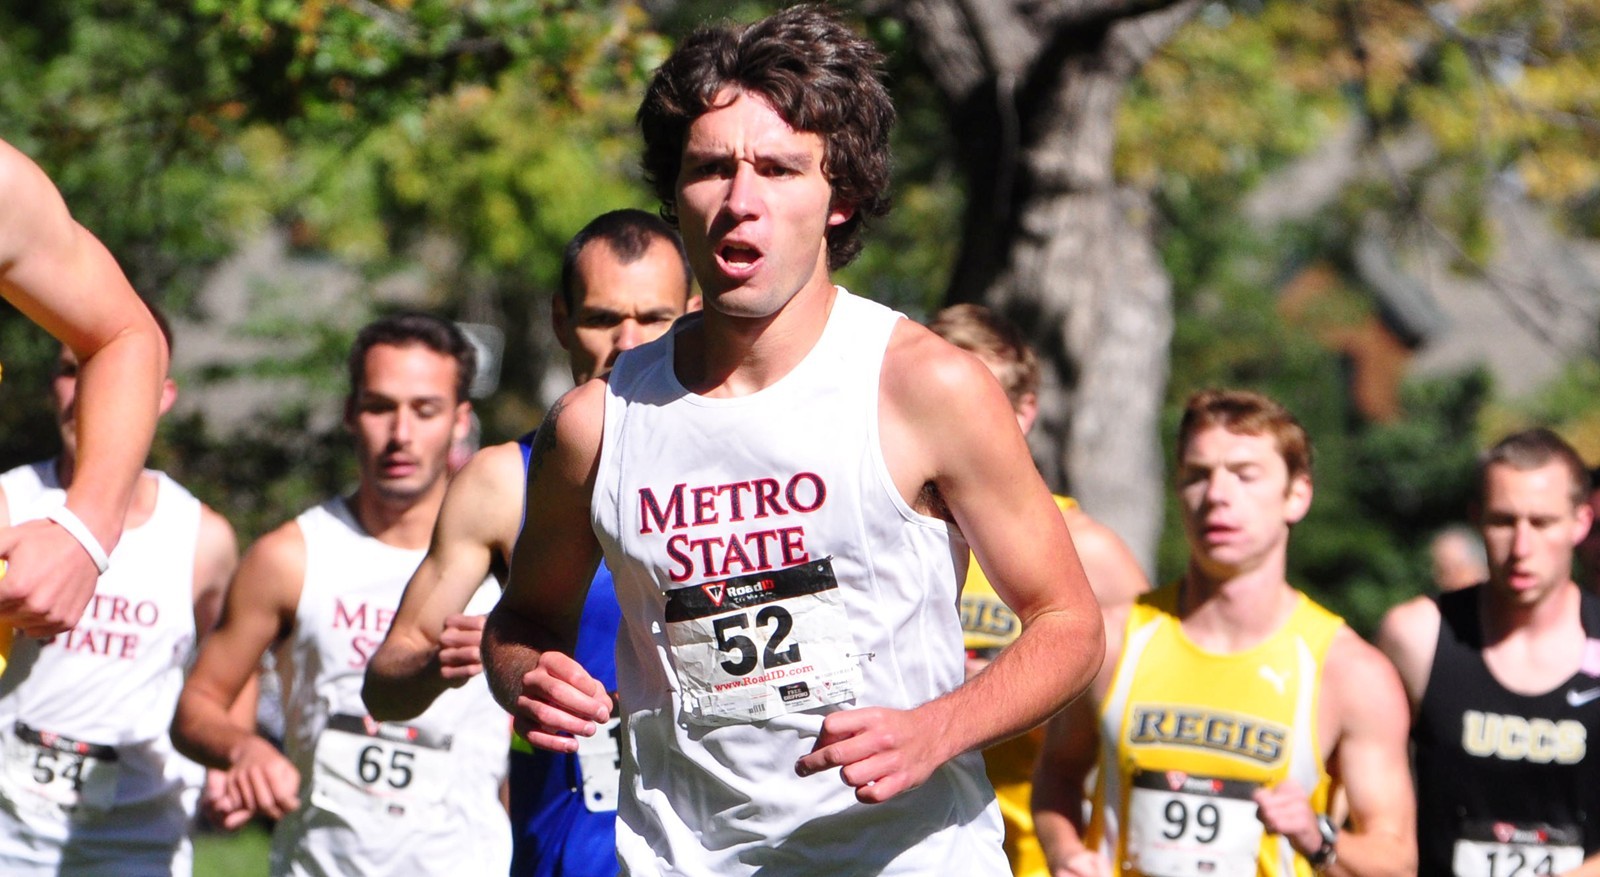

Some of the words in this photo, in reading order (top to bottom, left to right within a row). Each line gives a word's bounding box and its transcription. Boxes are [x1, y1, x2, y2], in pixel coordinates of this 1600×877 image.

[638, 472, 826, 534] METRO
[666, 526, 809, 582] STATE
[92, 594, 159, 627] TRO
[63, 626, 140, 659] TATE
[713, 605, 802, 677] 52
[714, 664, 815, 692] www.RoadID.com
[1131, 706, 1287, 764] REGIS
[1462, 709, 1588, 765] UCCS
[32, 751, 83, 792] 54
[358, 745, 415, 789] 65
[1162, 799, 1221, 844] 99
